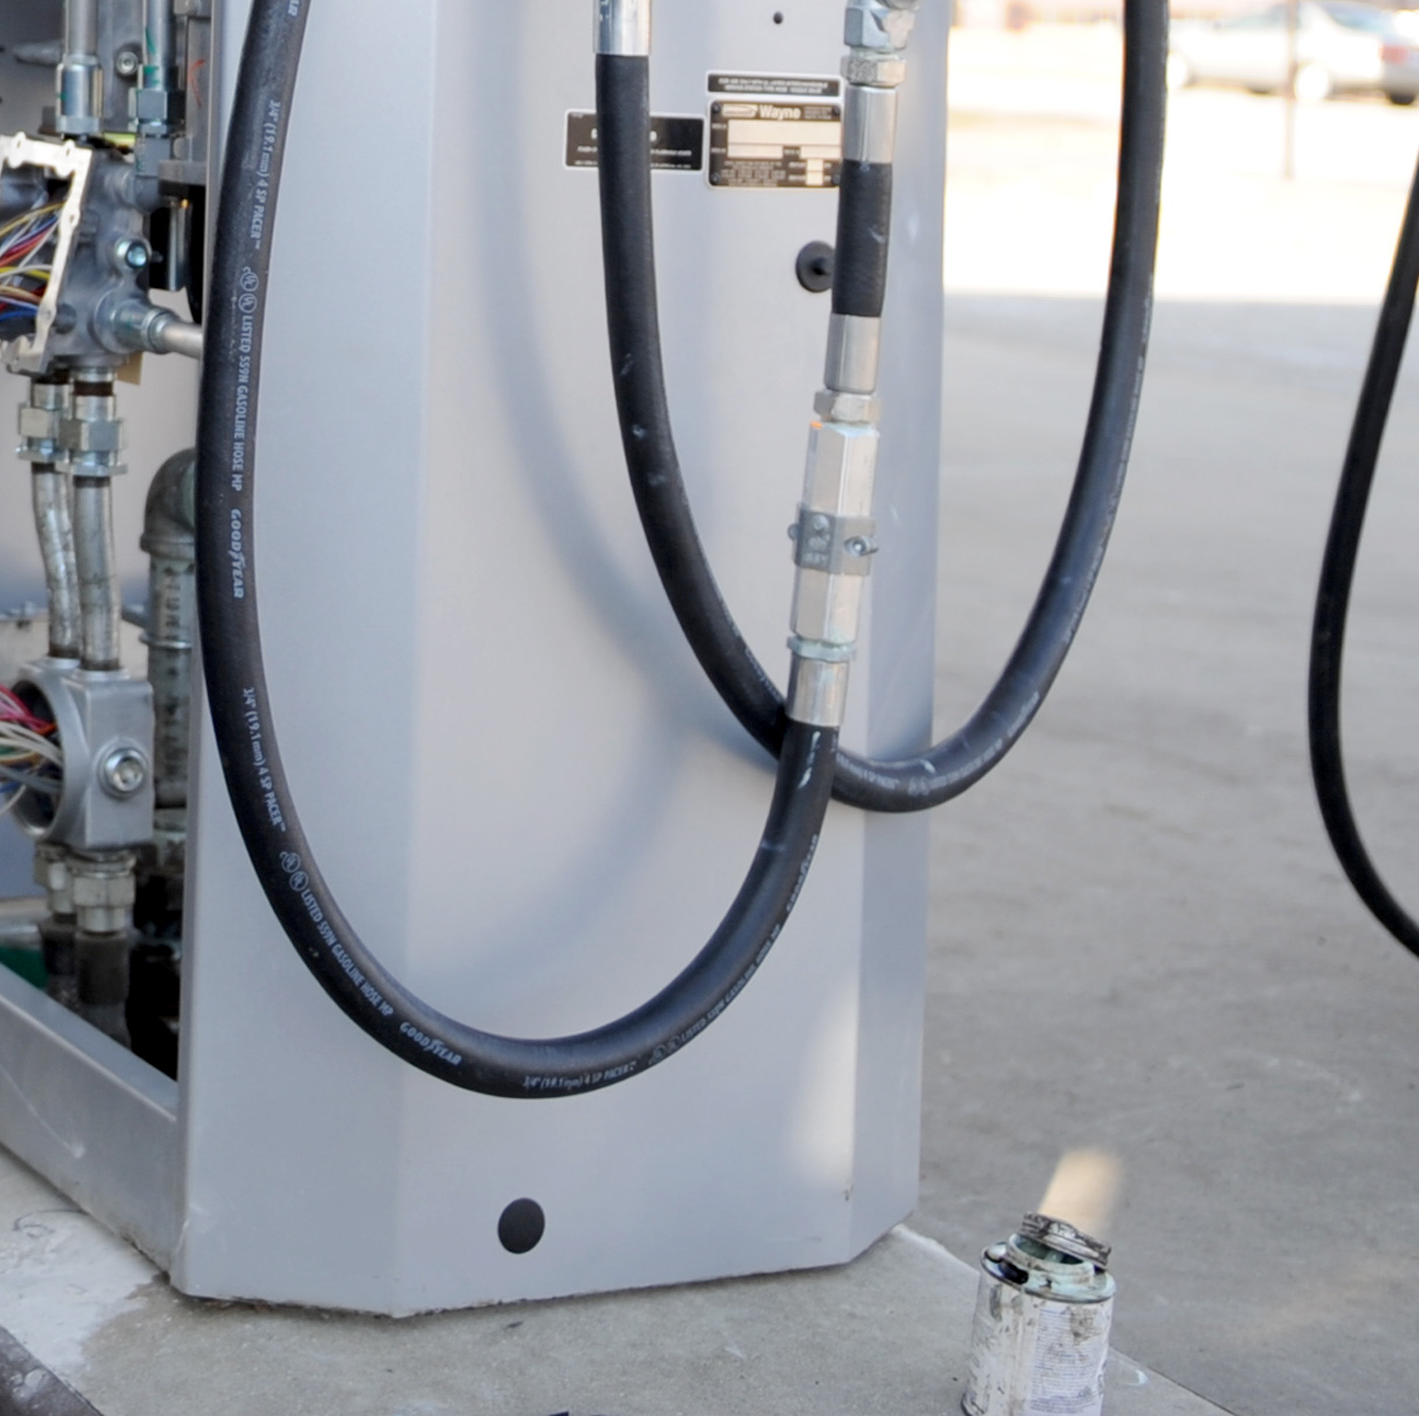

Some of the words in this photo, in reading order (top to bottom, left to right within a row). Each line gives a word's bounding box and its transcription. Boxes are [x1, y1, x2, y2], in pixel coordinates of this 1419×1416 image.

[759, 104, 801, 121] Wayne
[238, 314, 253, 354] LISTED
[234, 385, 249, 439] GASOLINE
[232, 440, 245, 471] HOSE
[231, 473, 243, 492] MP
[228, 508, 246, 599] GOODYEAR
[244, 710, 267, 766] (19.1mm)
[300, 889, 323, 923] LISTED
[331, 943, 364, 987] GASOLINE
[360, 982, 383, 1008] HOSE
[378, 1000, 394, 1017] MP
[399, 1021, 462, 1066] GOODYEAR
